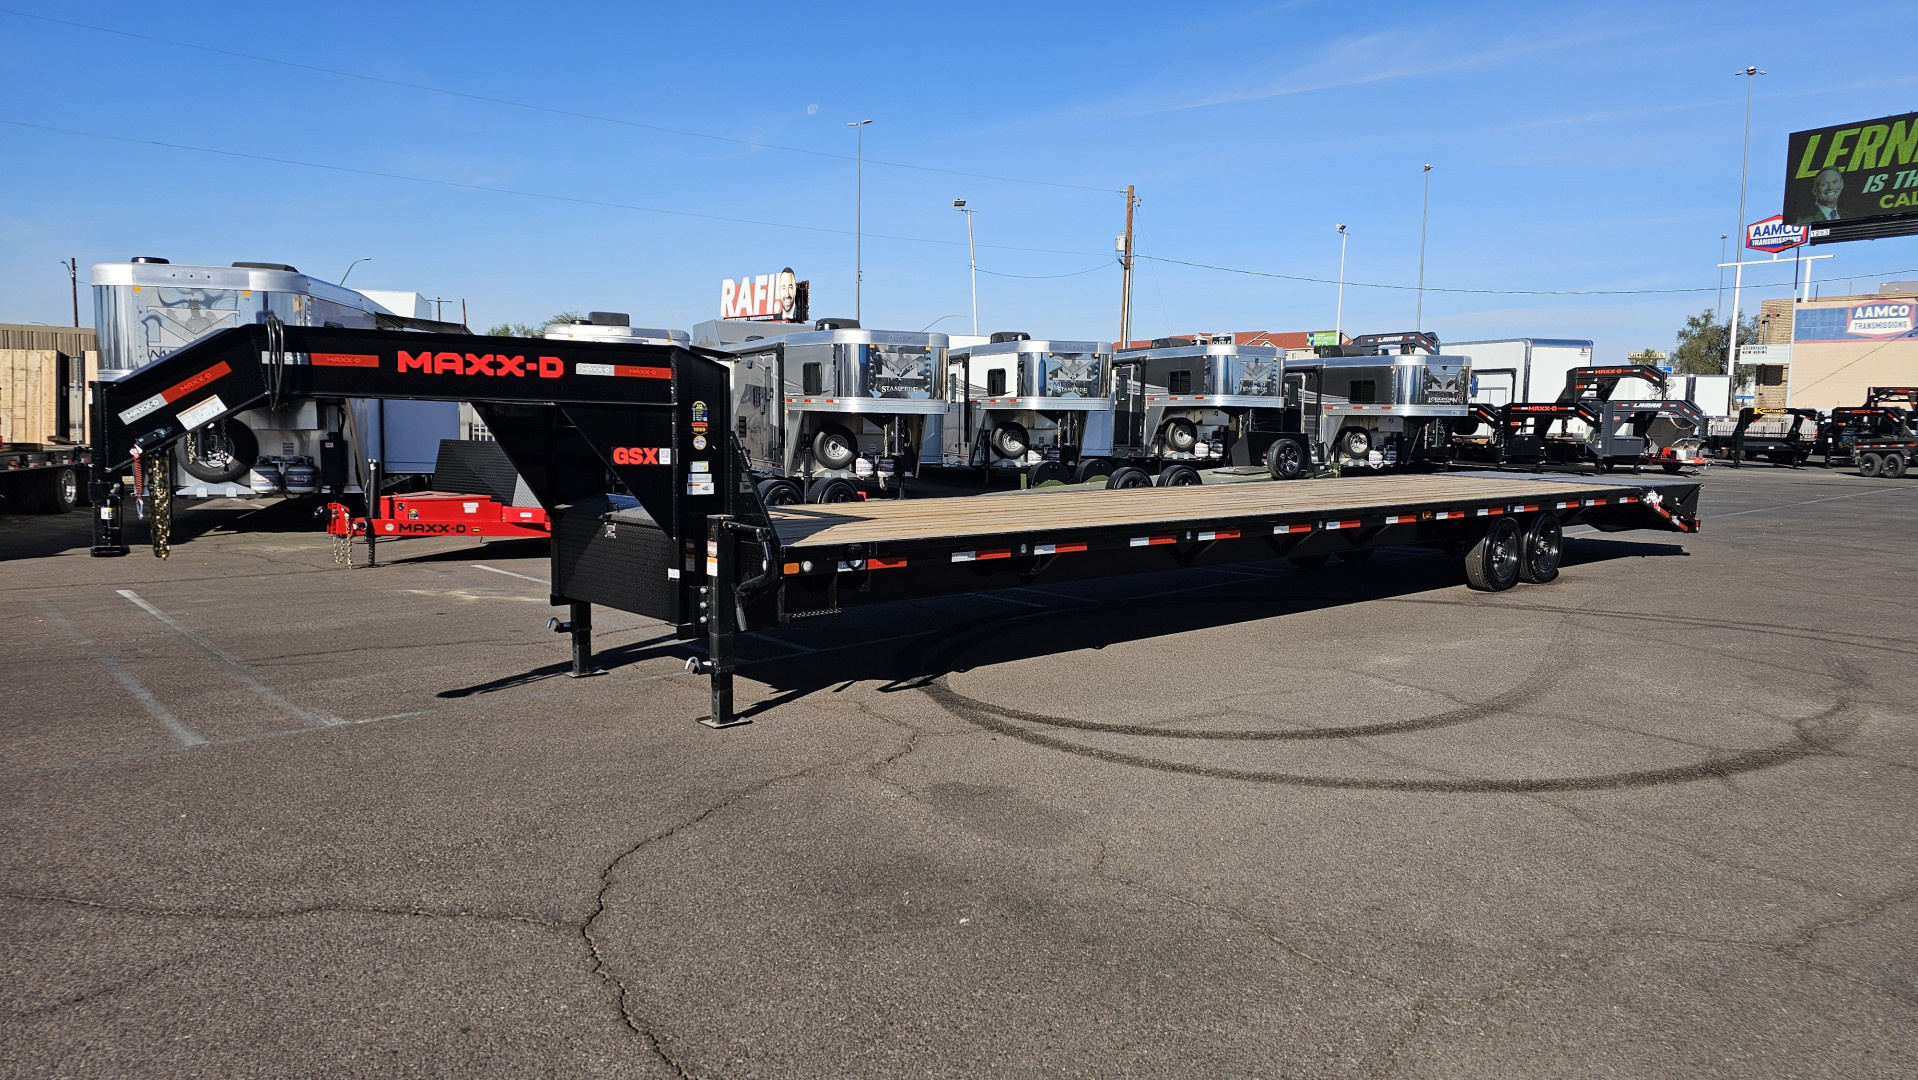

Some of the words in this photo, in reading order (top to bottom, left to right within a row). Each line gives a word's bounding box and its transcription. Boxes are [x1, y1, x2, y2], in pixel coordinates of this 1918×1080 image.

[1795, 118, 1918, 179] LERN
[1862, 173, 1889, 193] IS
[1753, 223, 1801, 237] AAMCO
[1752, 235, 1801, 246] TRANSMISSIONS
[720, 272, 782, 318] RAFI!
[1854, 305, 1910, 319] AAMCO
[1854, 320, 1908, 330] TRANSMISSIONS
[397, 350, 564, 378] MAXX-D
[179, 371, 212, 392] MAXX-D
[126, 398, 160, 418] MAXX-D
[612, 447, 658, 465] GSX
[398, 523, 467, 533] MAXX-D
